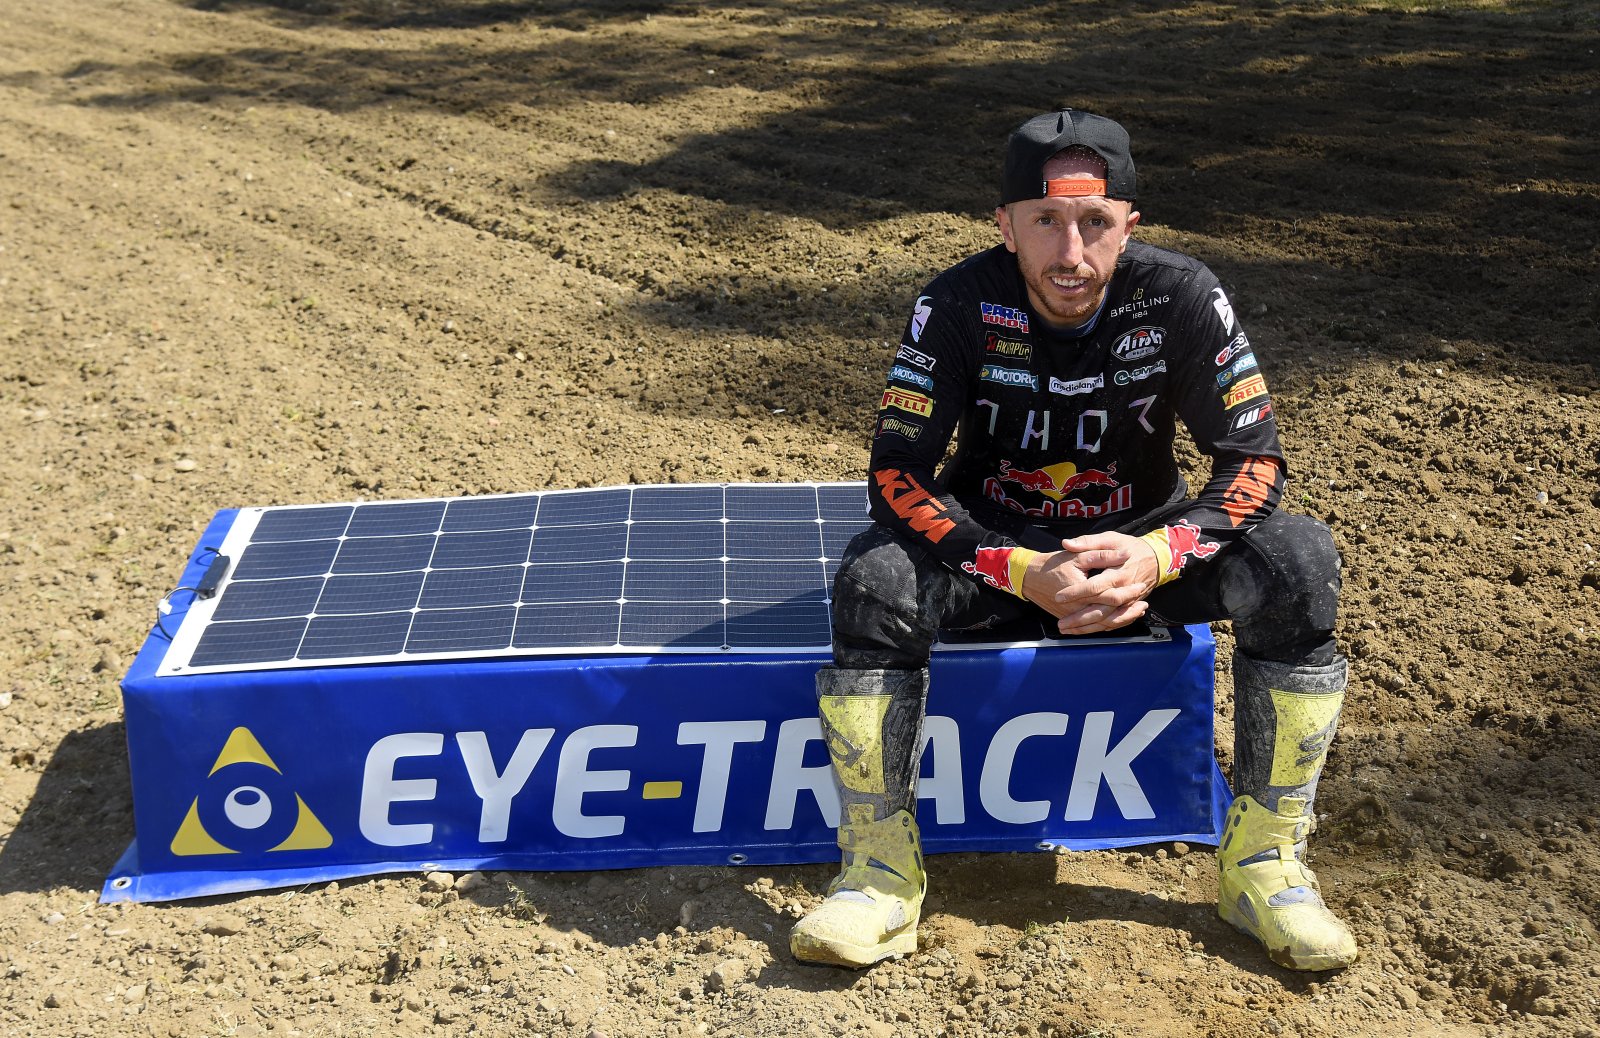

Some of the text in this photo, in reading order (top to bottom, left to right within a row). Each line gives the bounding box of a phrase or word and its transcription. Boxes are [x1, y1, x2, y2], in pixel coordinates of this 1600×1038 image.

[1110, 294, 1170, 318] BREITLING
[1116, 330, 1162, 354] Airoh
[873, 468, 957, 544] KTM
[1058, 484, 1132, 519] Bull
[358, 708, 1182, 848] EYE-TRACK
